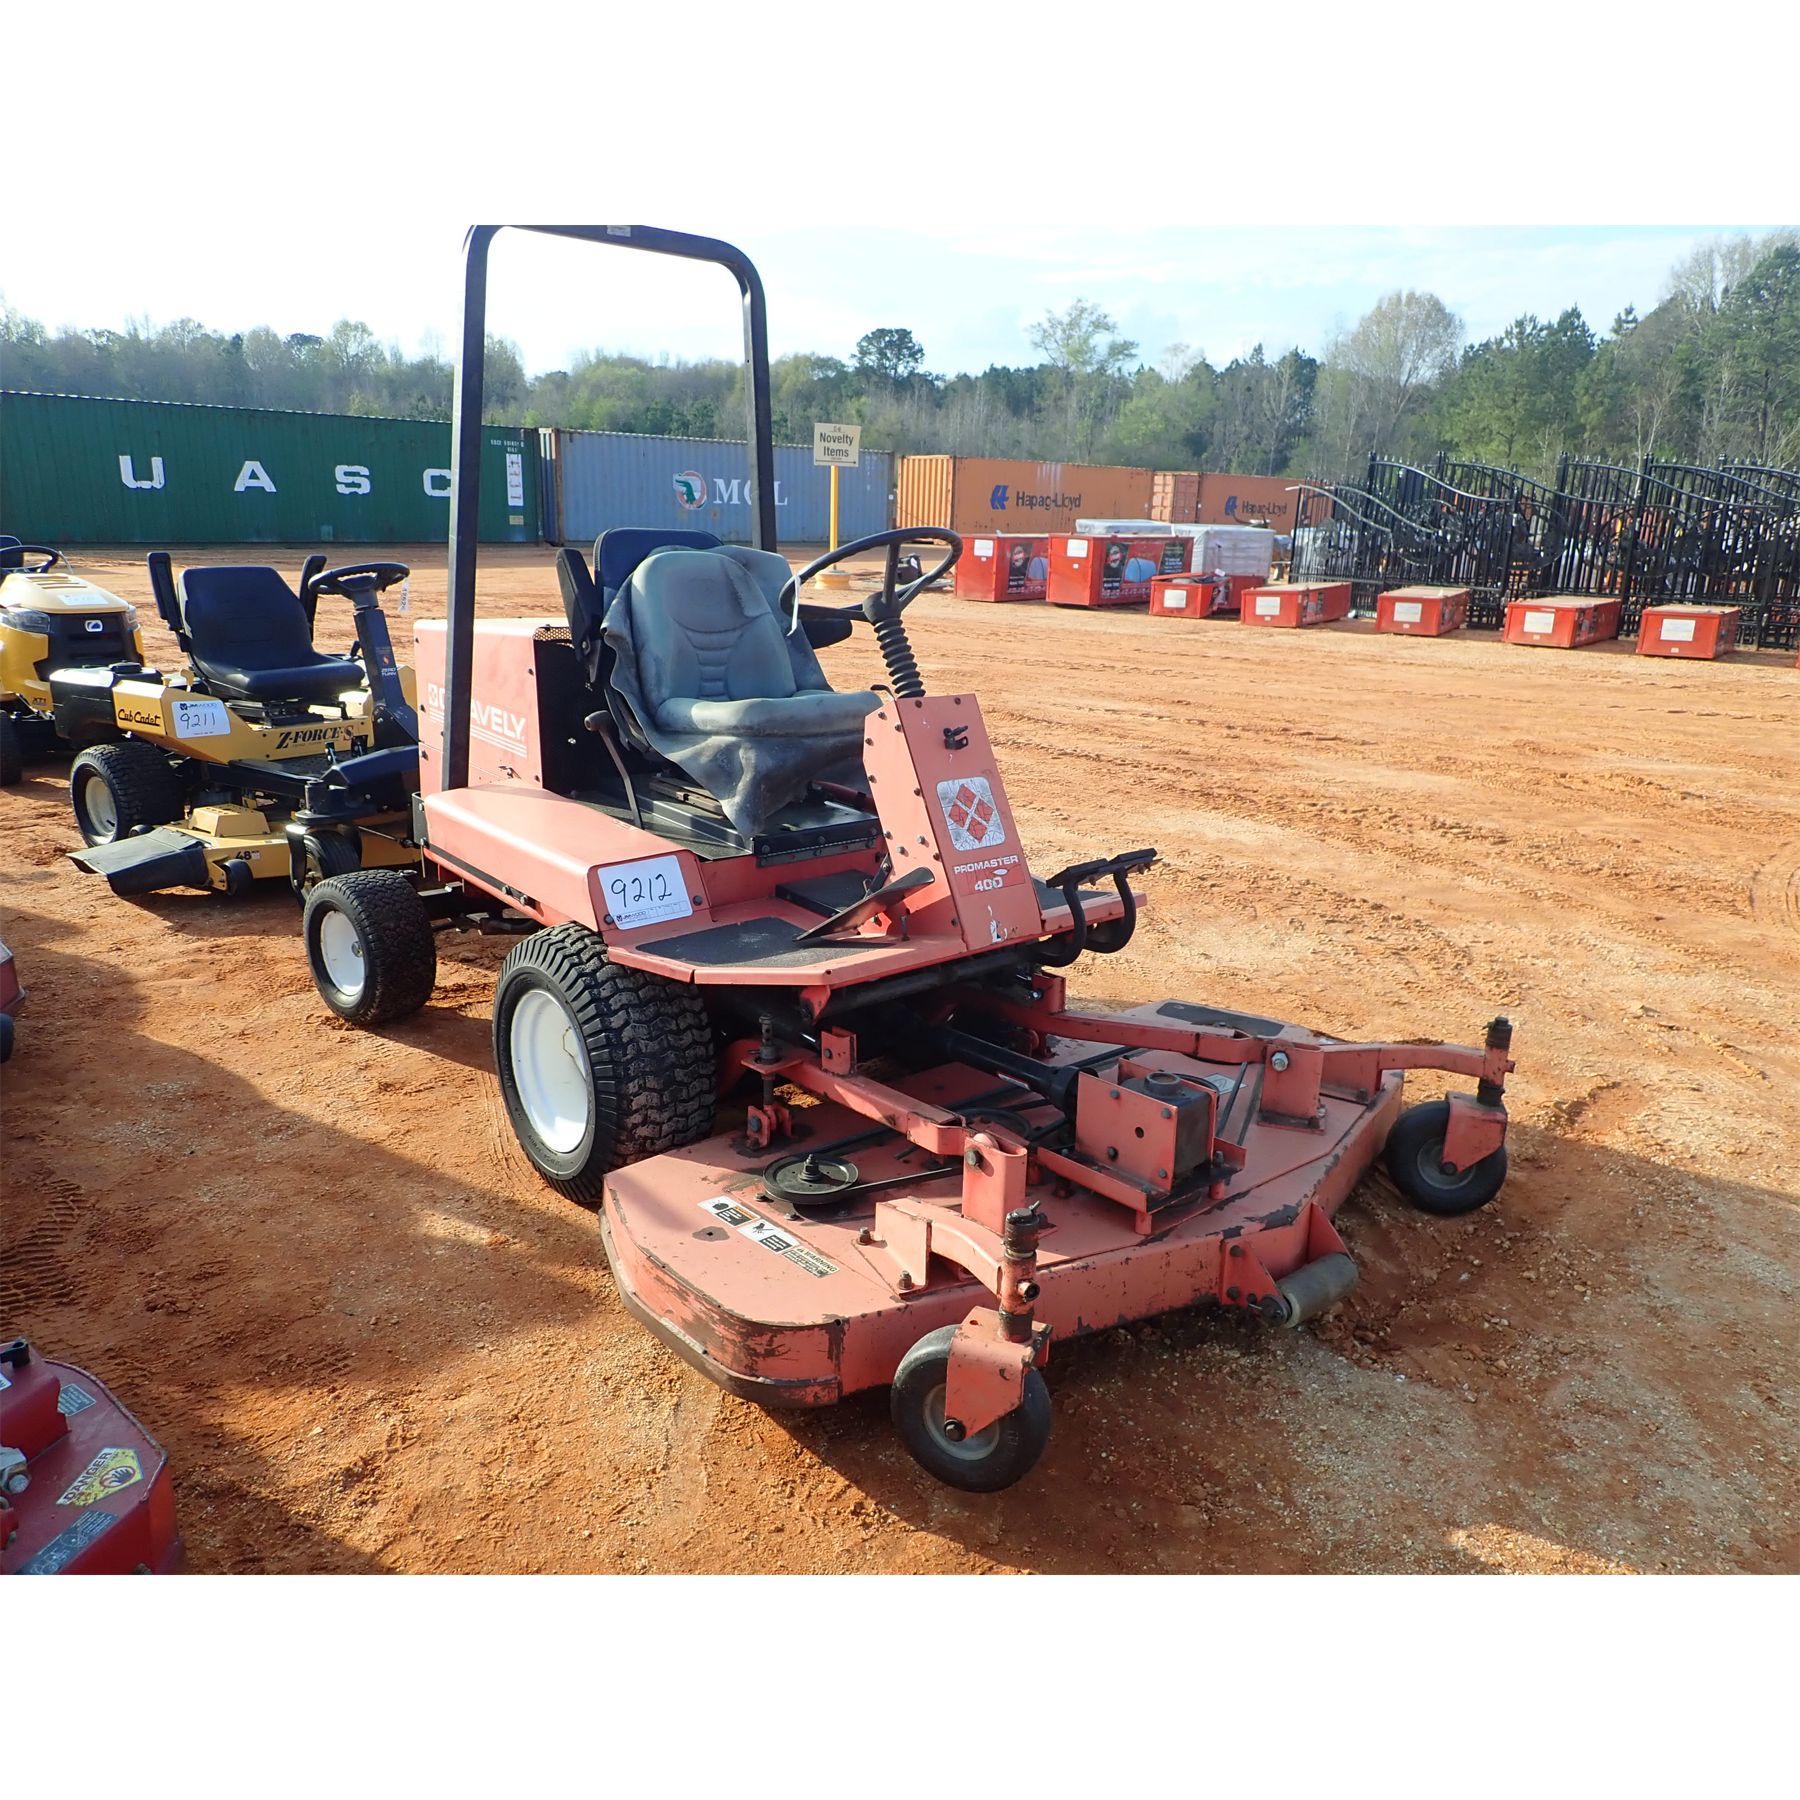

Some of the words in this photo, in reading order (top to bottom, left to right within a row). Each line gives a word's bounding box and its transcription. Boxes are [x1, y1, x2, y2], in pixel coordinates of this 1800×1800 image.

[820, 432, 854, 447] Novelty
[823, 446, 849, 457] Items
[118, 708, 133, 723] Cub
[133, 711, 161, 727] Cadet
[180, 712, 216, 730] 9211
[953, 855, 1019, 875] PROMASTER
[611, 874, 672, 908] 9212
[974, 877, 1003, 892] 400
[63, 1452, 113, 1501] DANGER
